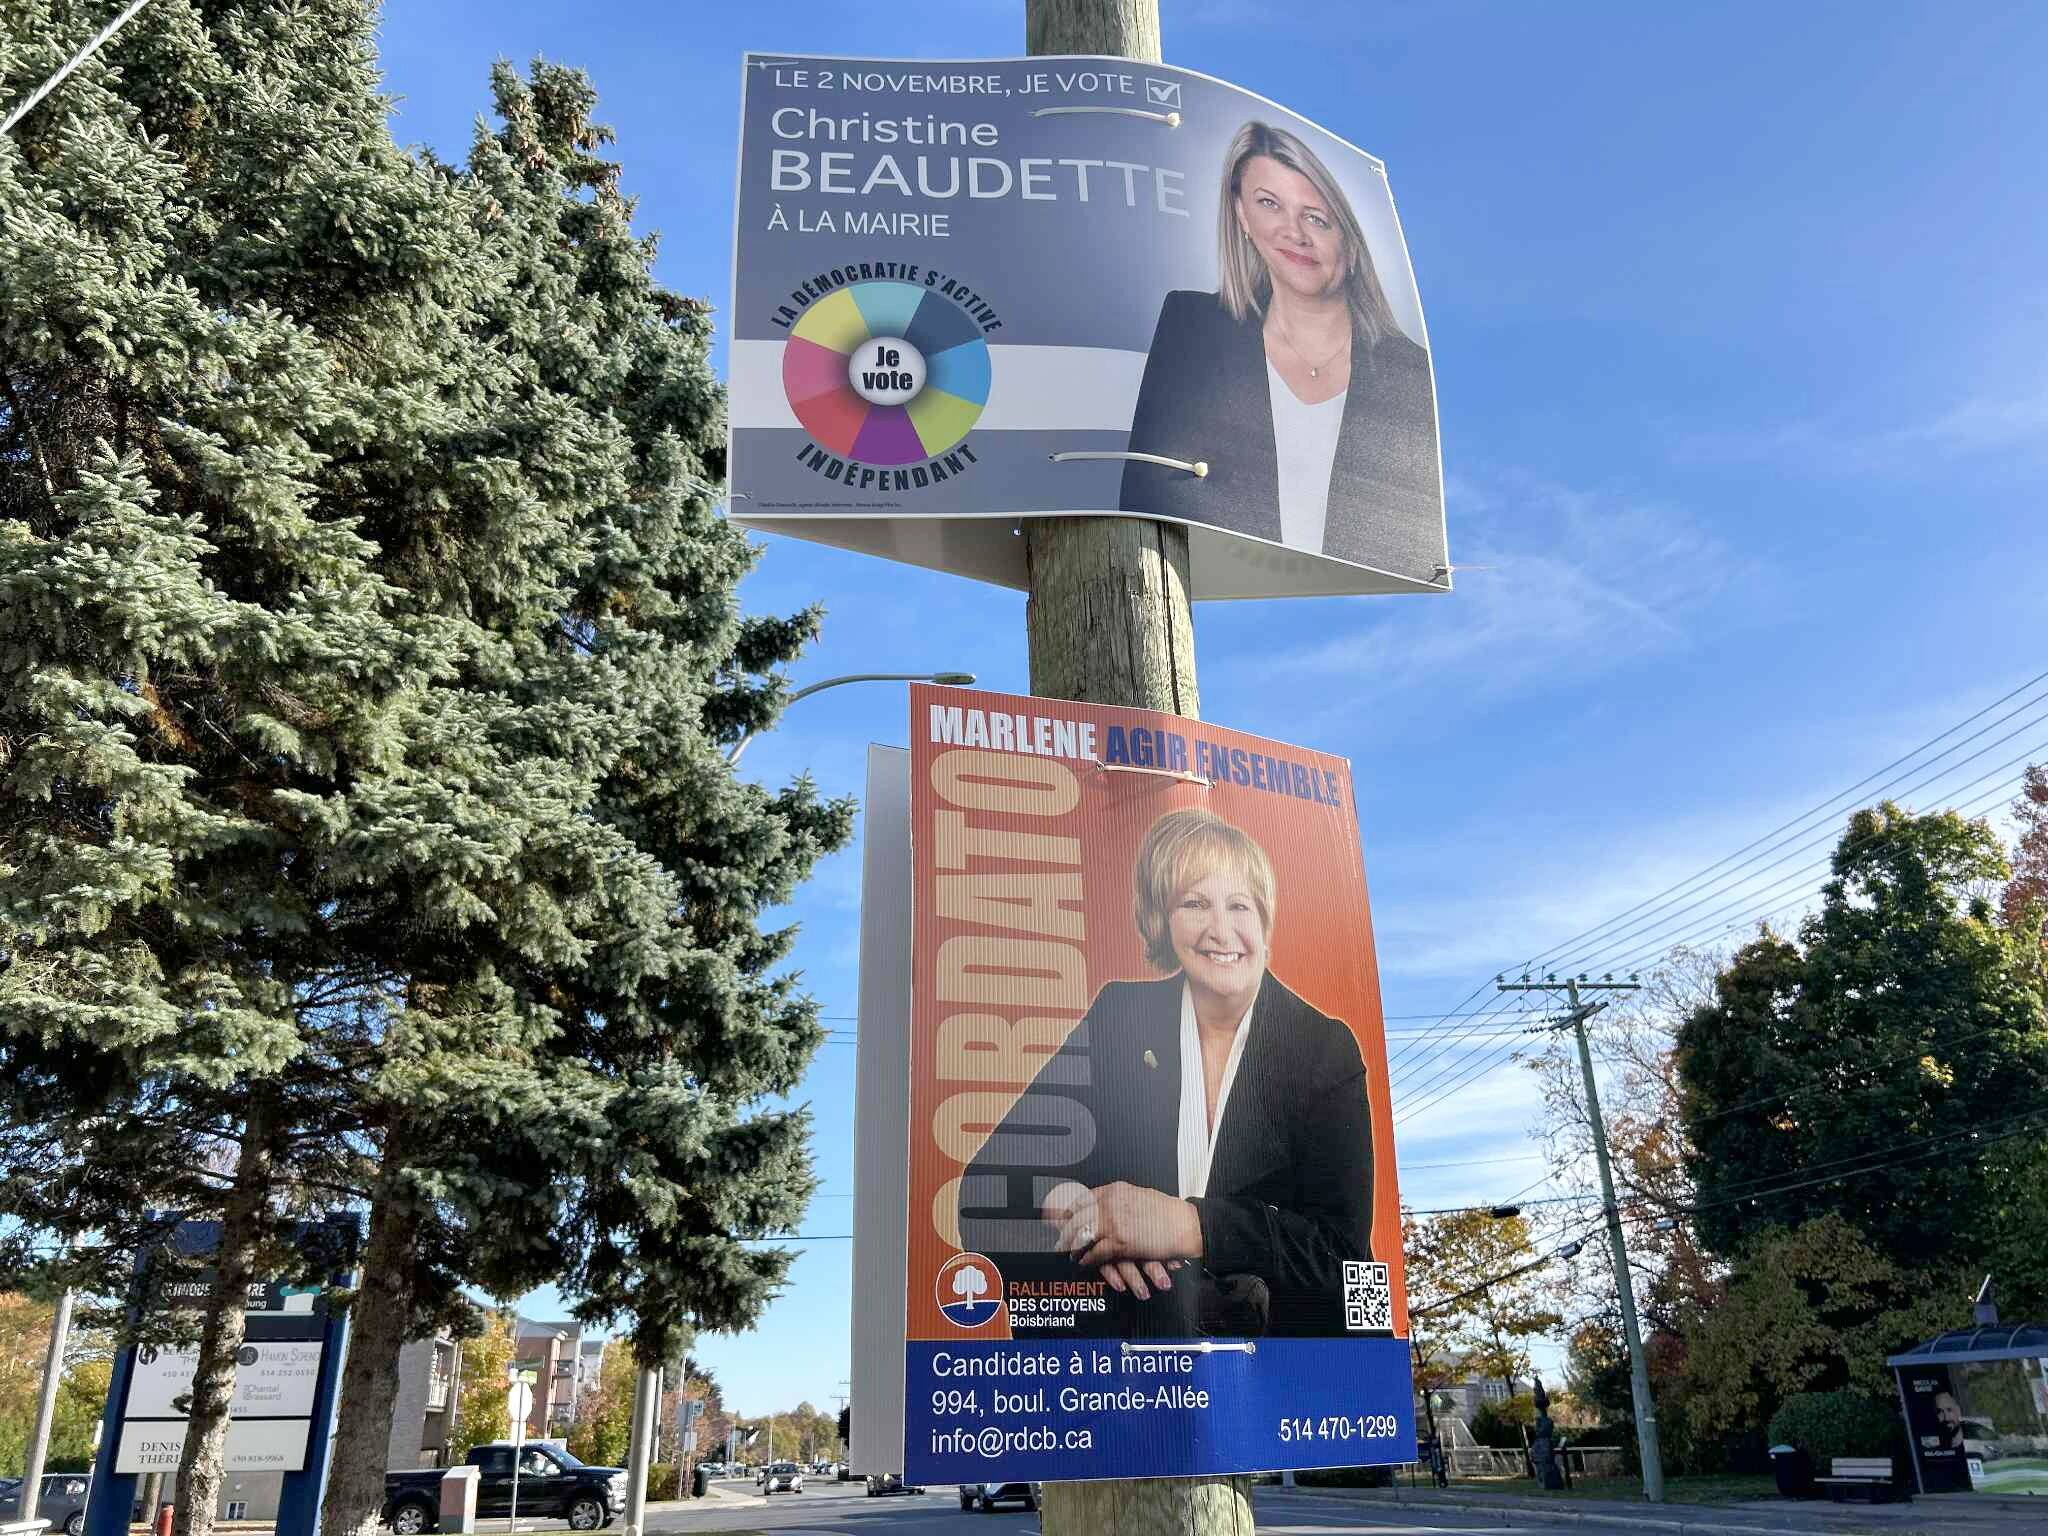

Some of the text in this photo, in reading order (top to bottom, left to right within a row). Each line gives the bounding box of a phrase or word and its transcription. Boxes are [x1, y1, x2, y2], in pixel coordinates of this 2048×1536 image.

[774, 70, 1136, 97] LE 2 NOVEMBRE, JE VOTE
[771, 107, 999, 146] Christine
[770, 149, 1190, 218] BEAUDETTE
[767, 203, 950, 237] À LA MAIRIE
[771, 262, 1003, 333] LA DÉMOCRATIE S'ACTIVE
[875, 346, 900, 367] Je
[862, 370, 913, 391] vote
[796, 443, 978, 491] INDÉPENDANT
[930, 703, 1341, 809] MARLENE AGIR ENSEMBLE
[930, 748, 1097, 1253] CORDATO
[1009, 1281, 1106, 1297] RALLIEMENT
[1009, 1298, 1106, 1312] DES CITOYENS
[1009, 1314, 1075, 1327] Boisbriand
[932, 1351, 1193, 1377] Candidate à la mairie
[931, 1385, 1209, 1417] 994, boul. Grande-Allée
[1280, 1415, 1397, 1441] 514 470-1299
[140, 1441, 182, 1452] DENIS
[931, 1426, 1093, 1458] info@rdcb.ca
[138, 1452, 180, 1464] THÉRI
